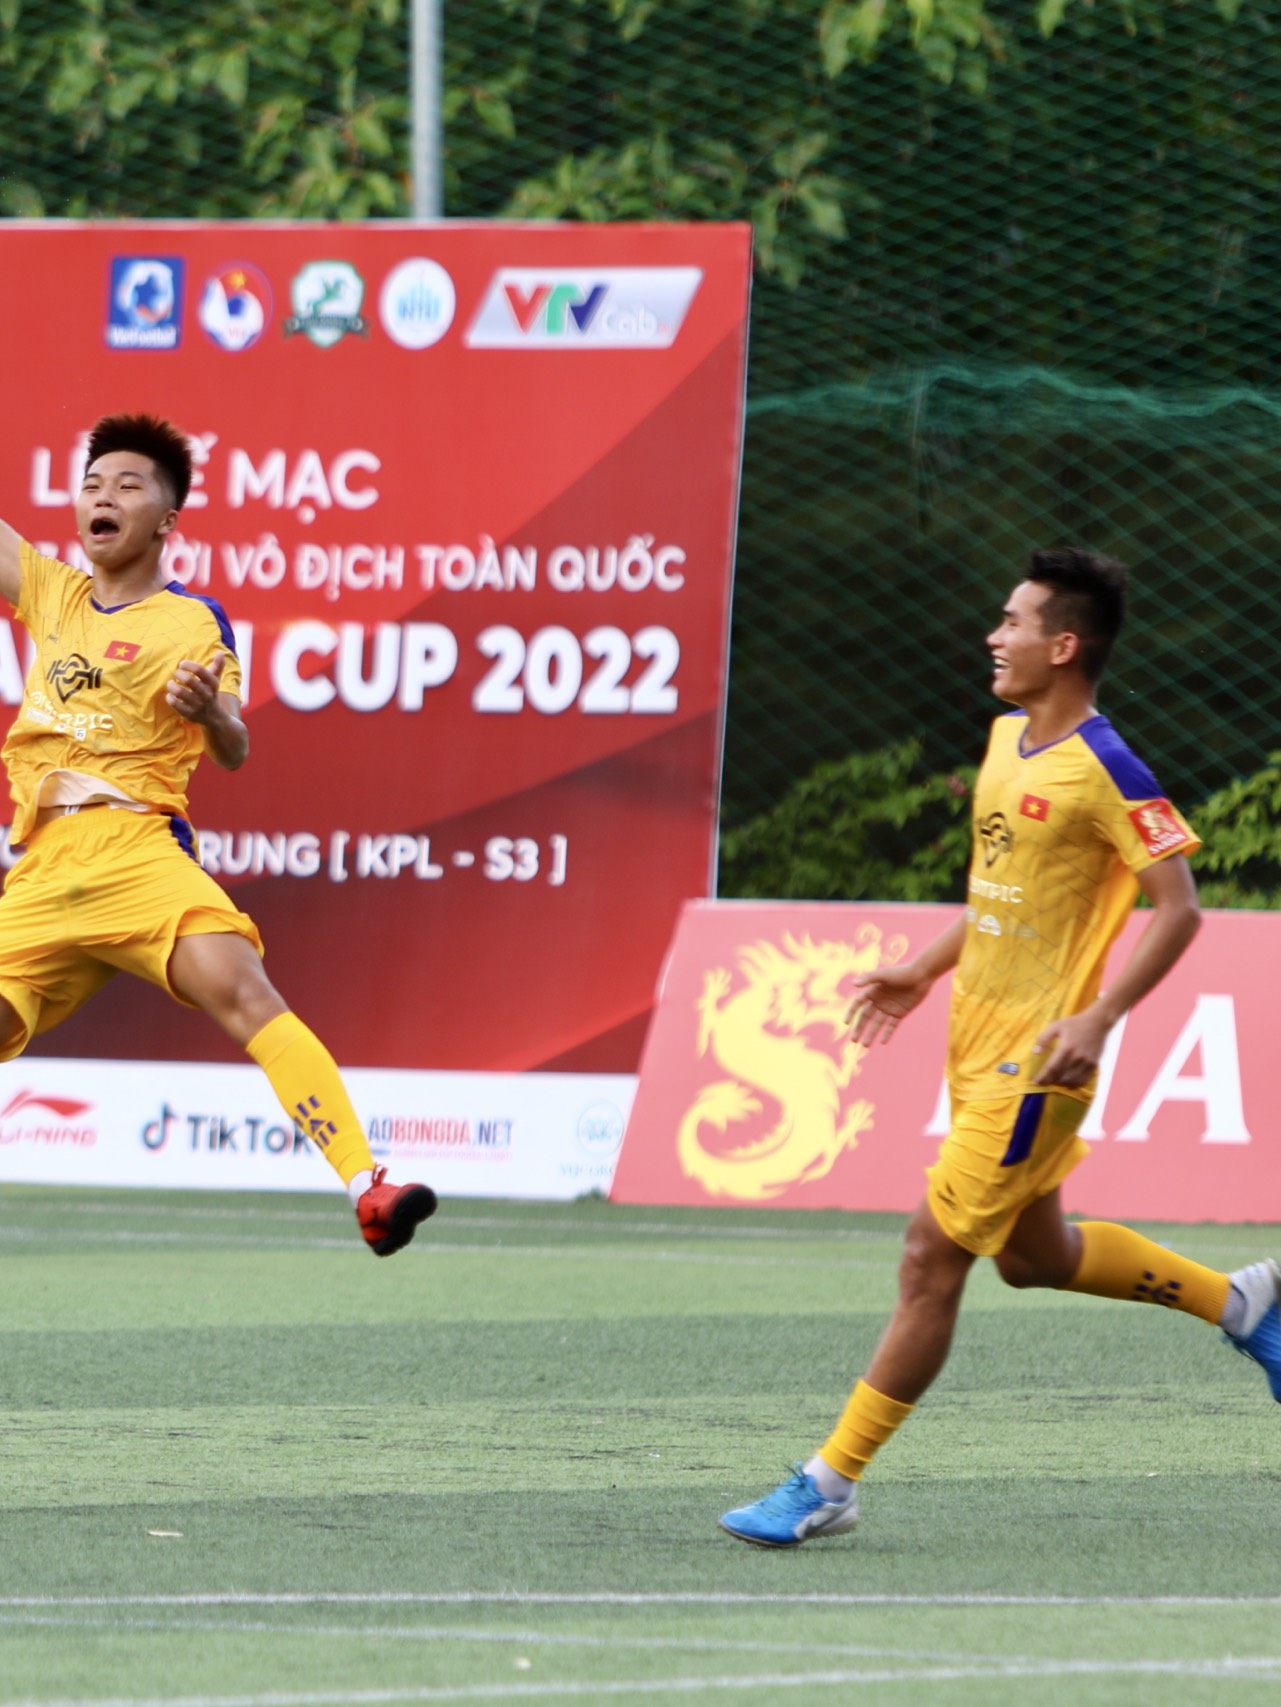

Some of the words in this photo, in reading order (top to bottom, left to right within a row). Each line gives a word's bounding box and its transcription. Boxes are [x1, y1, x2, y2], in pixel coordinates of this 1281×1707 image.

[227, 448, 381, 525] MẠC
[222, 533, 287, 589] VÔ
[296, 546, 405, 601] ĐỊCH
[417, 535, 538, 592] TOÀN
[547, 533, 687, 592] QUỐC
[269, 619, 459, 712] CUP
[471, 624, 681, 715] 2022
[198, 829, 320, 876] RUNG
[356, 832, 444, 878] KPL
[484, 835, 539, 882] S3
[185, 1114, 315, 1155] TikTok
